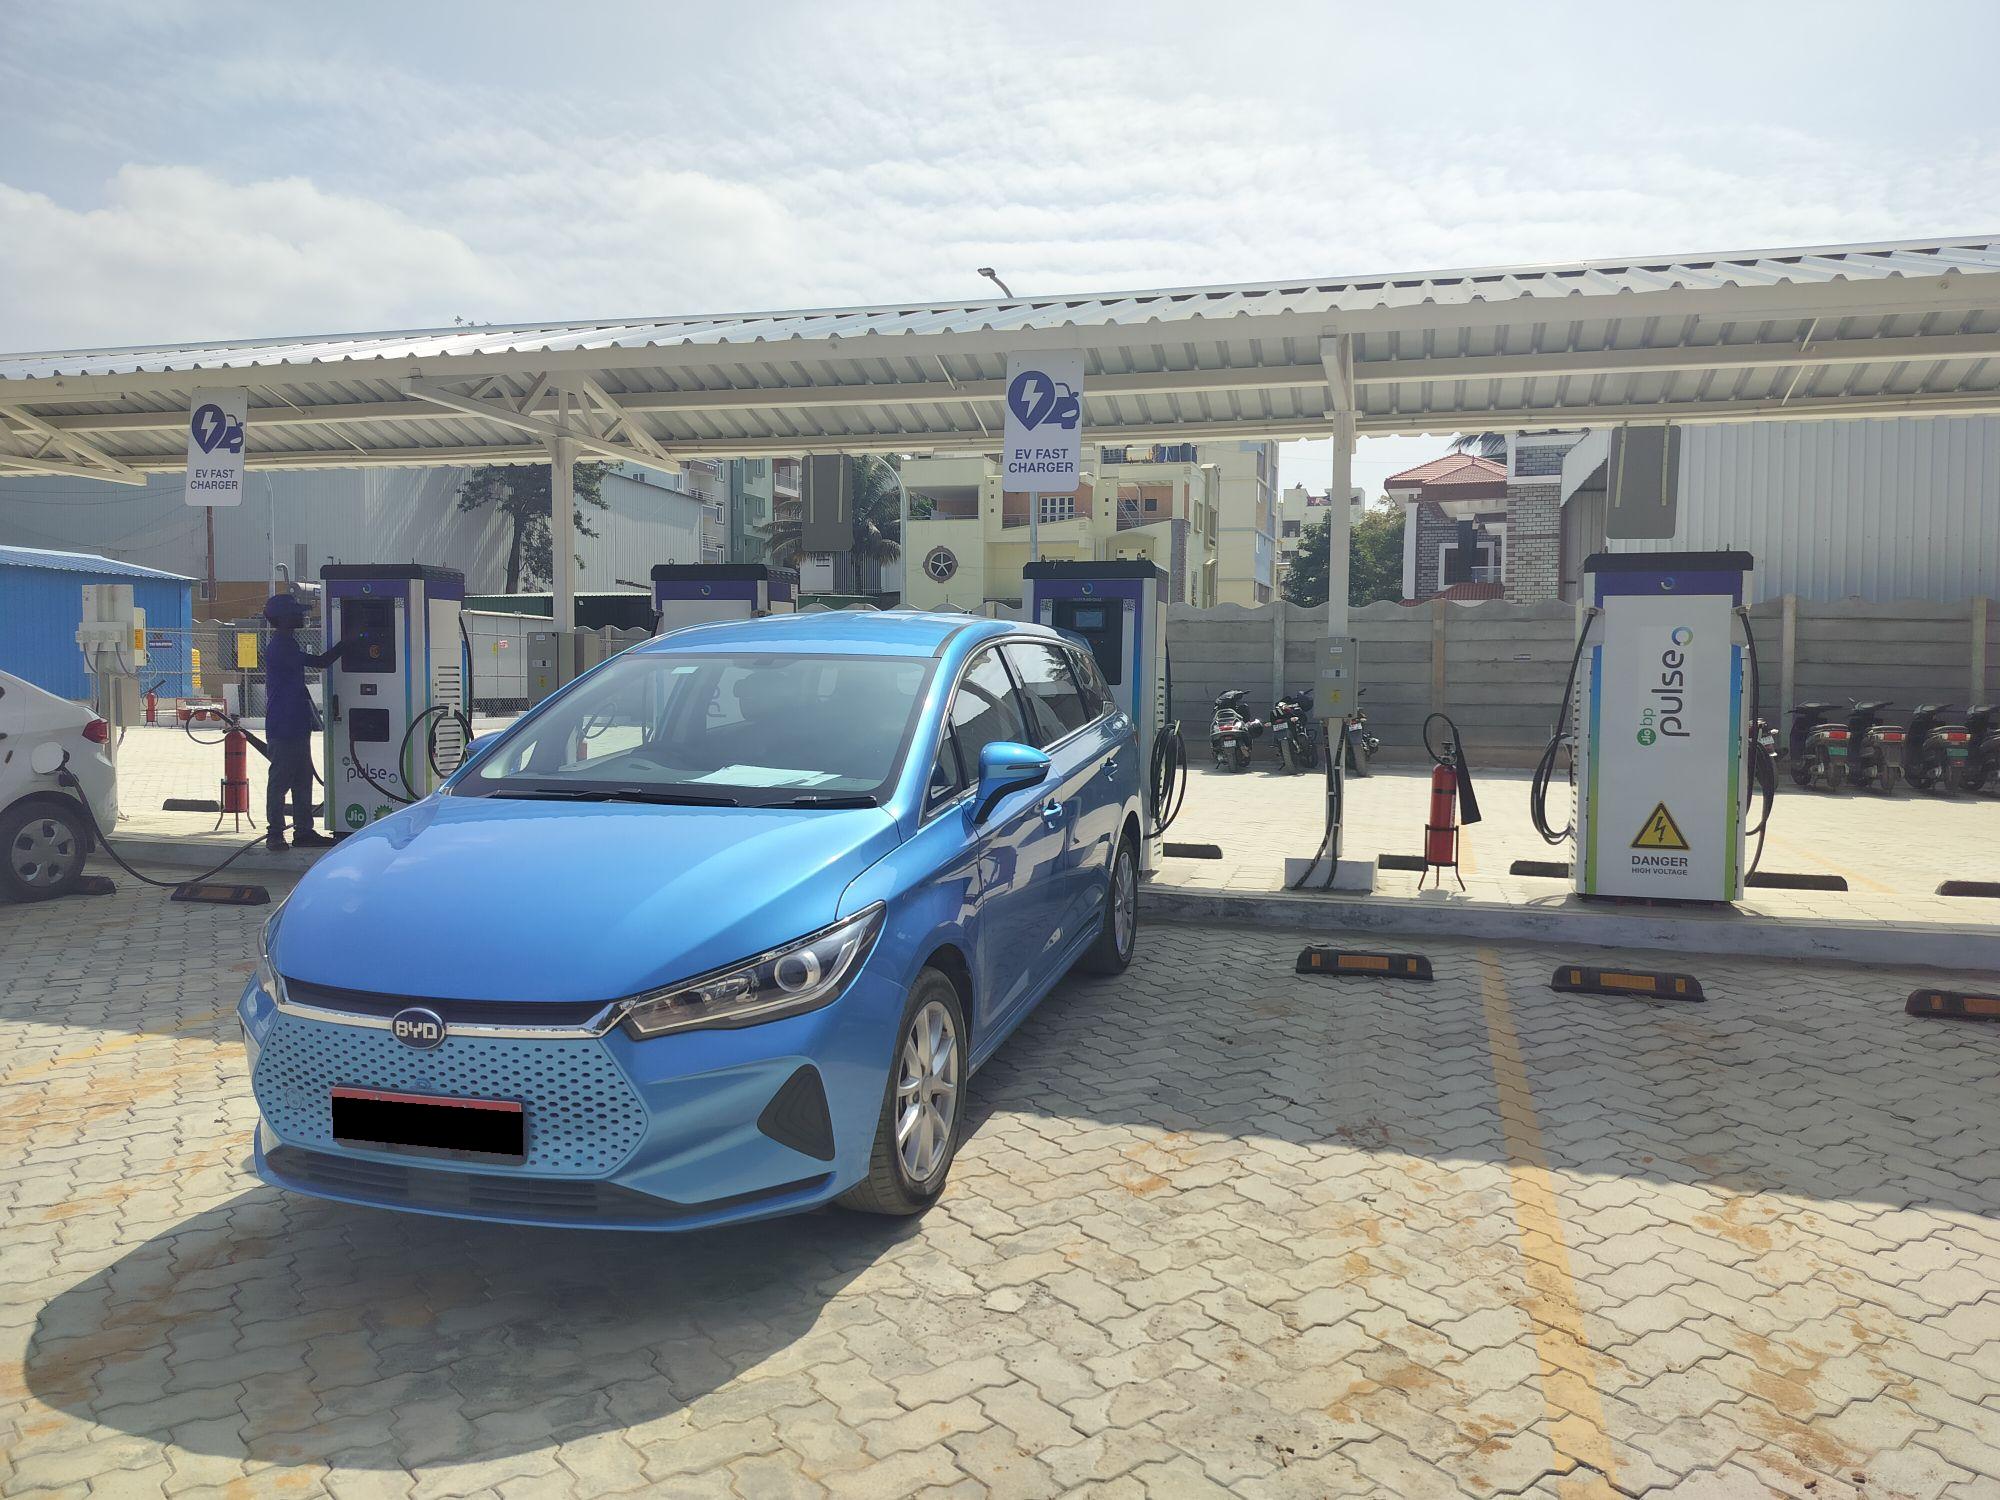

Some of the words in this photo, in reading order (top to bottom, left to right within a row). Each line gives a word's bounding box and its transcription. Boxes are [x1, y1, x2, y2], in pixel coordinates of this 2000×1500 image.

[1015, 448, 1032, 460] EV
[1035, 448, 1069, 459] FAST
[1008, 461, 1074, 473] CHARGER
[195, 469, 208, 478] EV
[210, 469, 235, 478] FAST
[190, 480, 238, 490] CHARGER
[1651, 649, 1690, 737] pulse
[1640, 707, 1657, 726] bp
[347, 808, 366, 822] Jio
[1631, 855, 1688, 867] DANGER
[1653, 868, 1688, 876] VOLTAGE
[395, 1020, 438, 1039] BYD
